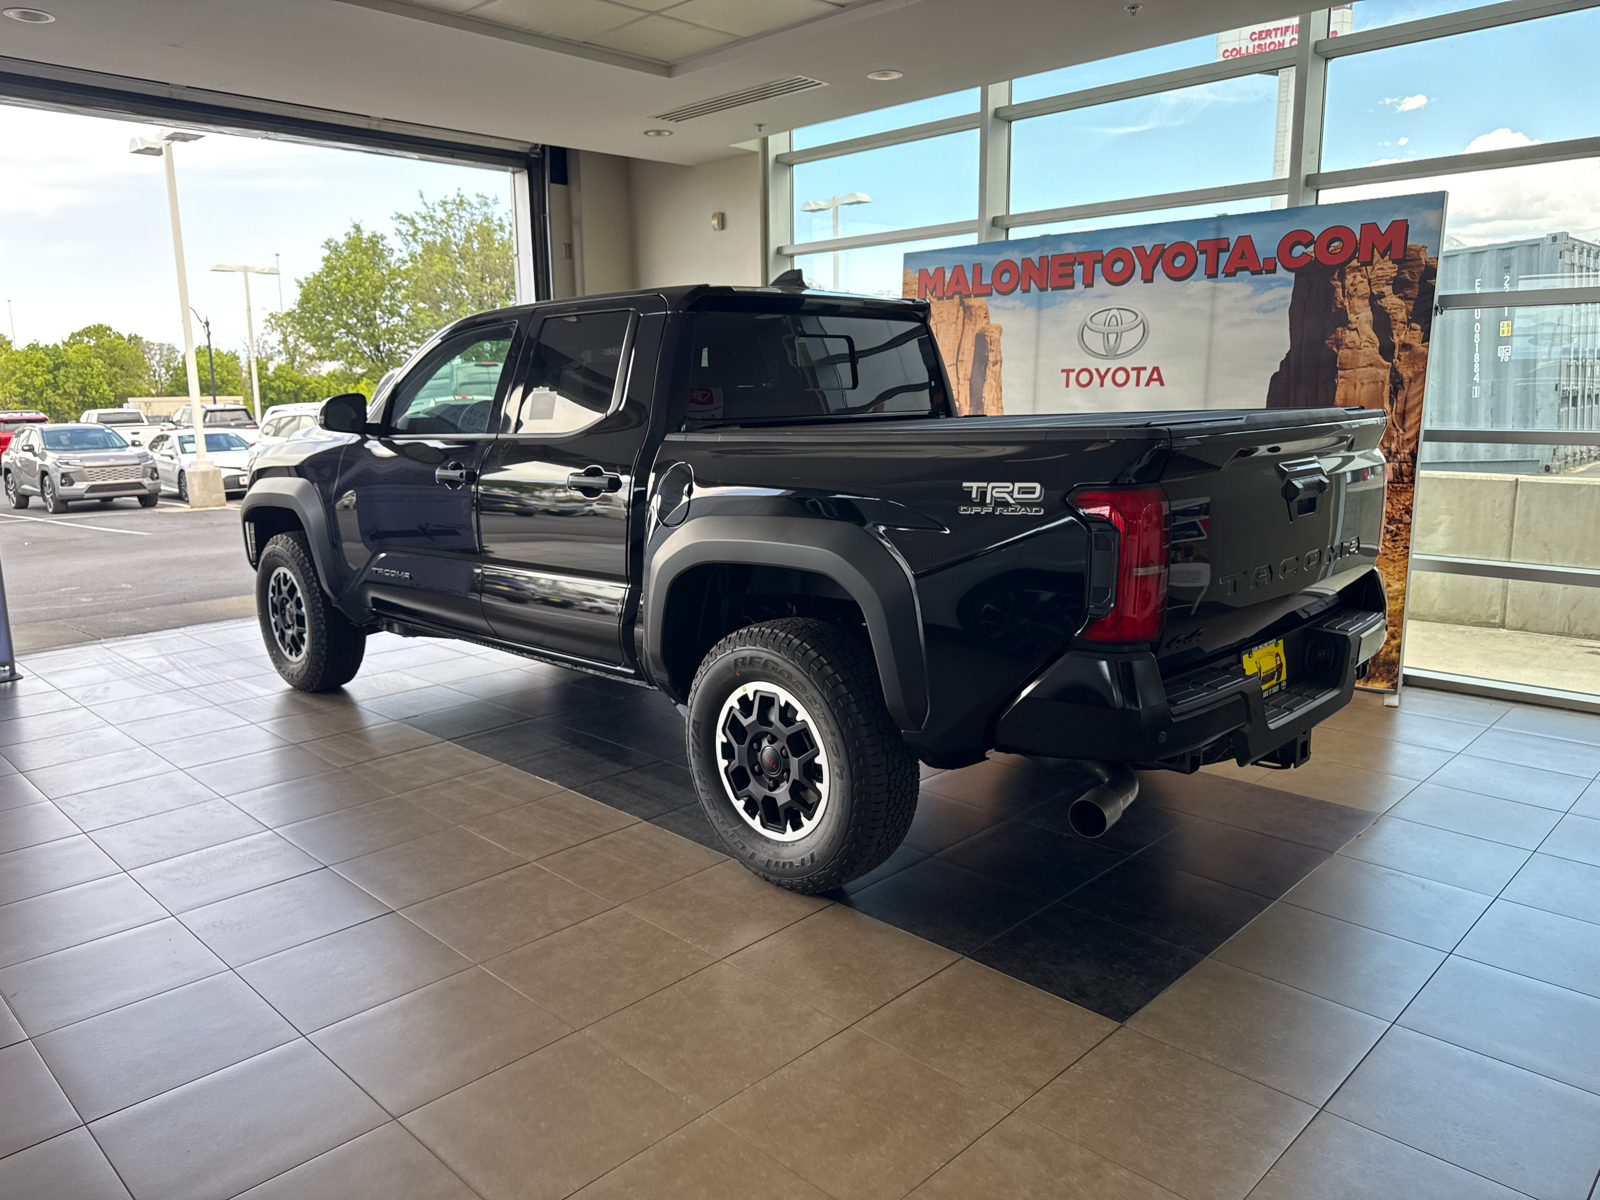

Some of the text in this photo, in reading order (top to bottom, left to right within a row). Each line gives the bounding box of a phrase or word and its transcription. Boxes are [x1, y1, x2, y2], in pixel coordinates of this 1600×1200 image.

[1222, 39, 1285, 59] COLLISION
[917, 219, 1409, 301] MALONETOYOTA.COM
[1473, 322, 1481, 383] 081884
[1061, 366, 1165, 389] TOYOTA
[962, 482, 1044, 507] TRD
[958, 505, 1044, 515] OFF ROAD
[371, 567, 412, 580] TACOMA
[1219, 536, 1360, 596] TACOMA
